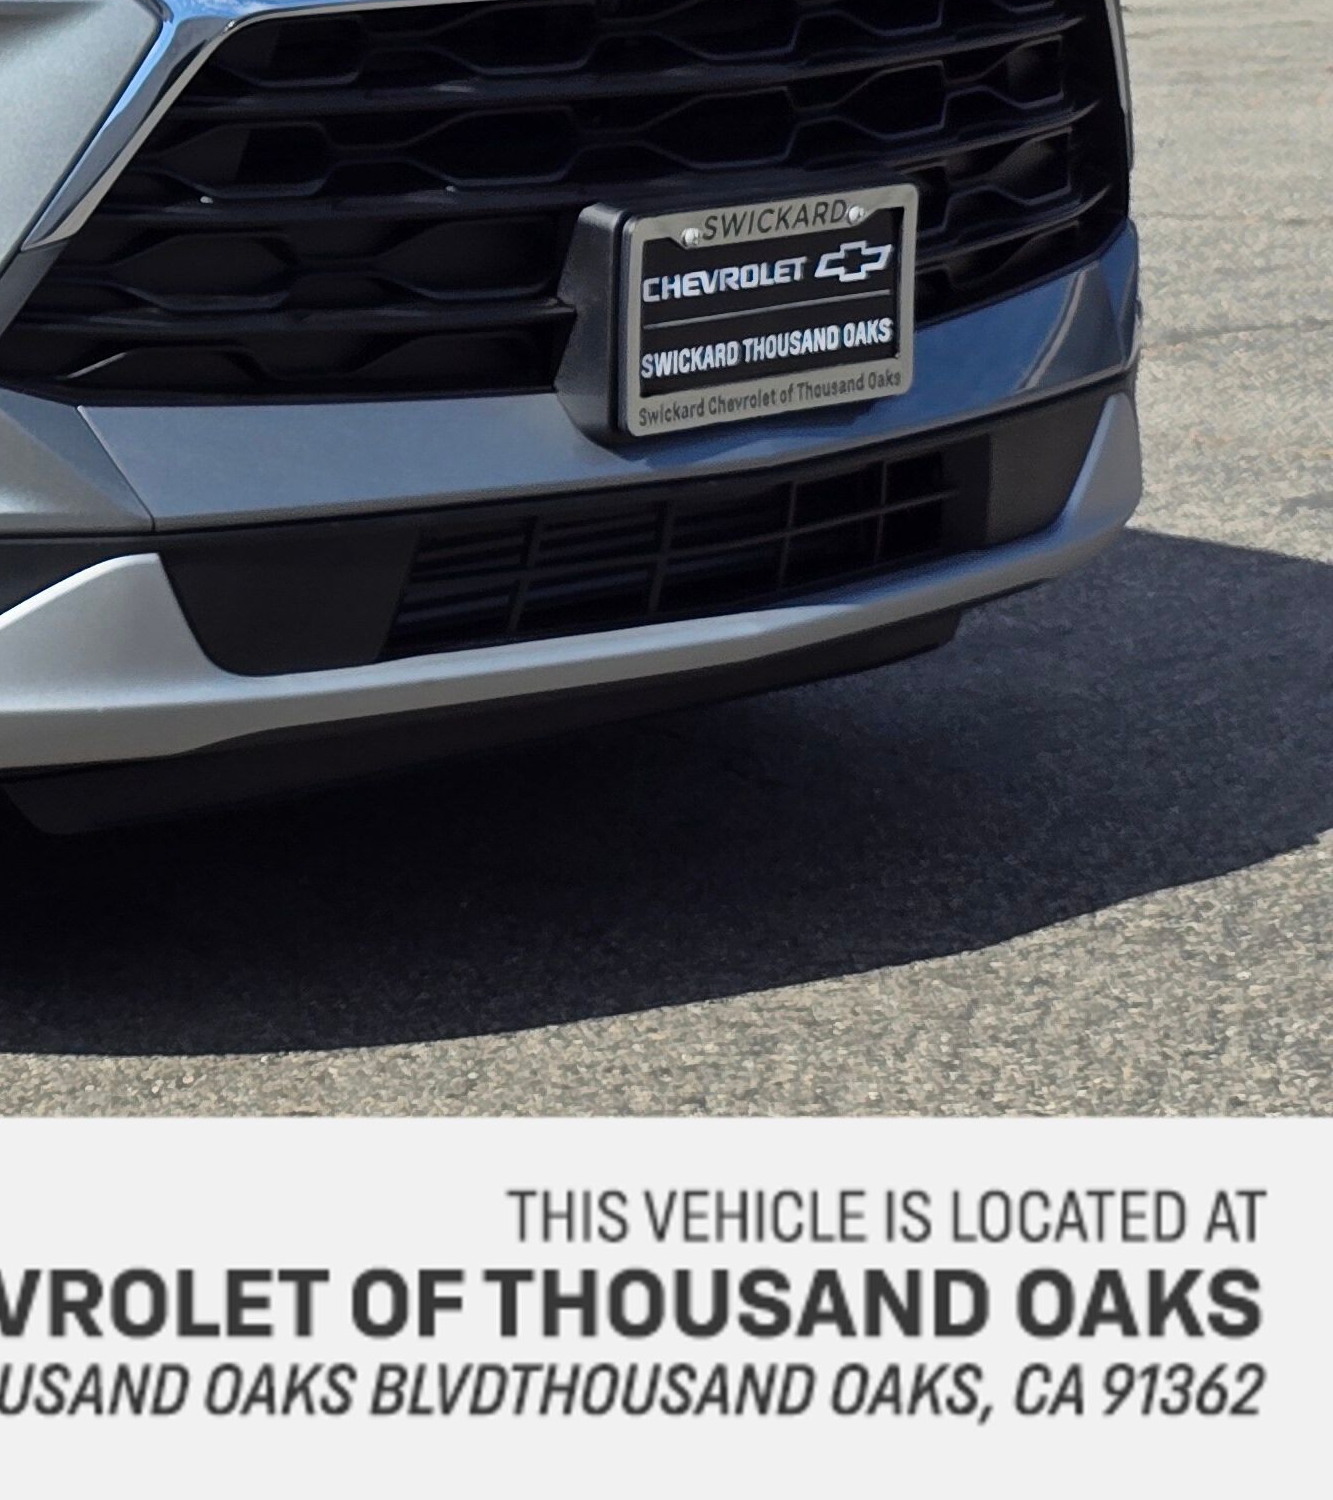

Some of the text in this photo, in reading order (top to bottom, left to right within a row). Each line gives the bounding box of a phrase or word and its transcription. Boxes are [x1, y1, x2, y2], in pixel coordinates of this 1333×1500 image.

[702, 198, 847, 240] SWICKARD
[642, 256, 807, 303] CHEVROLET
[640, 317, 894, 379] SWICKARD THOUSAND OAKS
[638, 369, 902, 428] Swickard Chevrolet of Thousand Oaks
